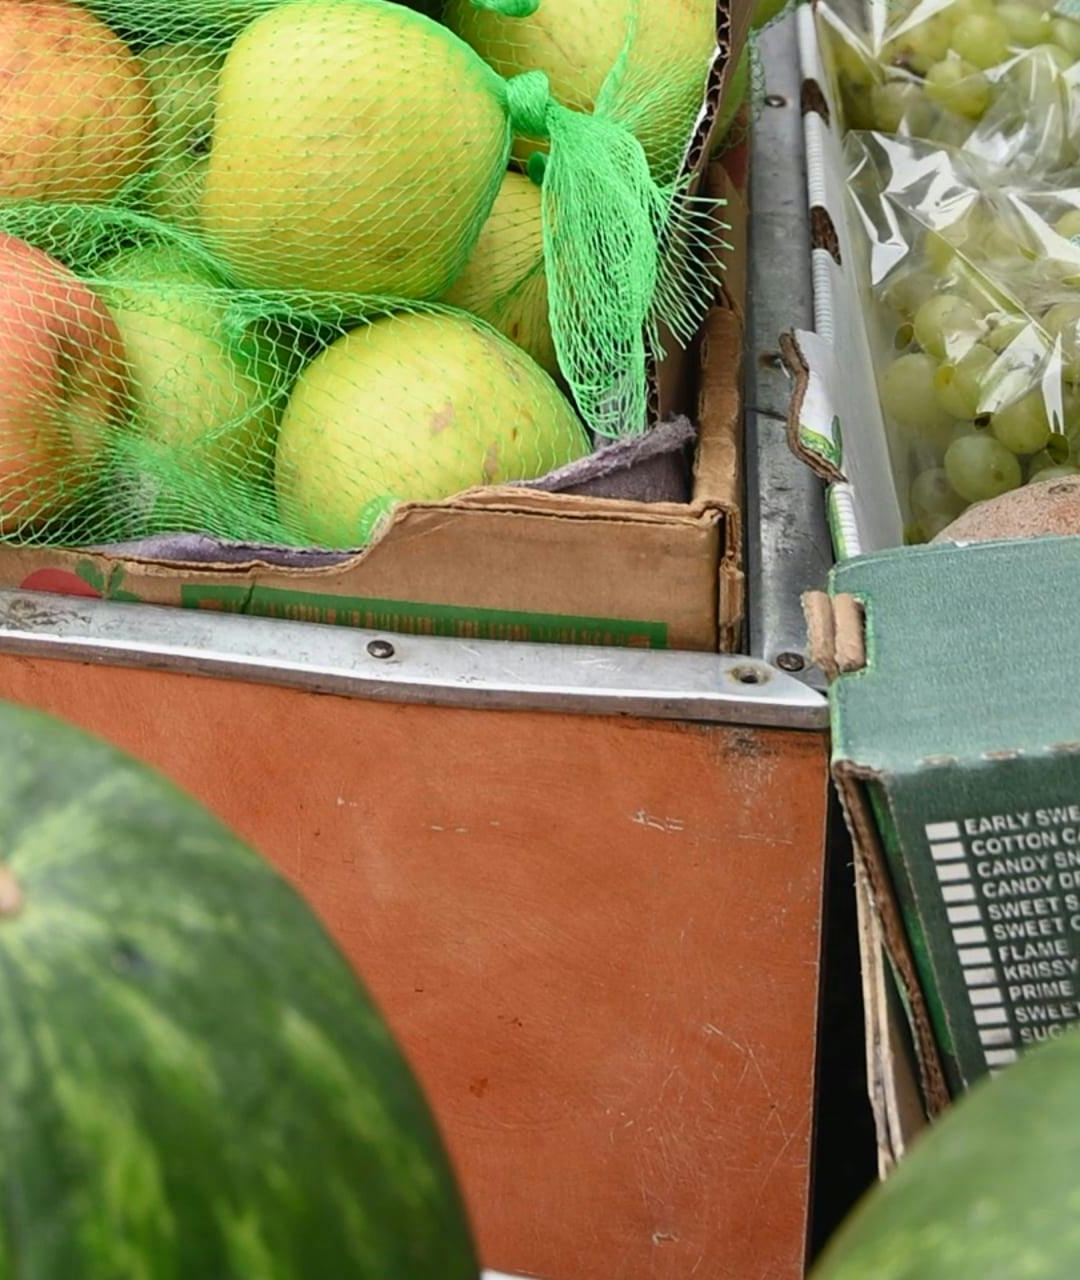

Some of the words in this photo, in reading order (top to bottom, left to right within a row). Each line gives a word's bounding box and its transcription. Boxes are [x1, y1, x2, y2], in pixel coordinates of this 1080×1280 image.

[964, 811, 1030, 835] EARLY
[971, 831, 1058, 856] COTTON
[1062, 827, 1080, 845] C
[977, 854, 1049, 878] CANDY
[982, 874, 1054, 898] CANDY
[987, 896, 1060, 921] SWEET
[993, 917, 1065, 940] SWEET
[998, 939, 1069, 963] FLAME
[1003, 958, 1079, 982] KRISSY
[1008, 980, 1074, 1002] PRIME
